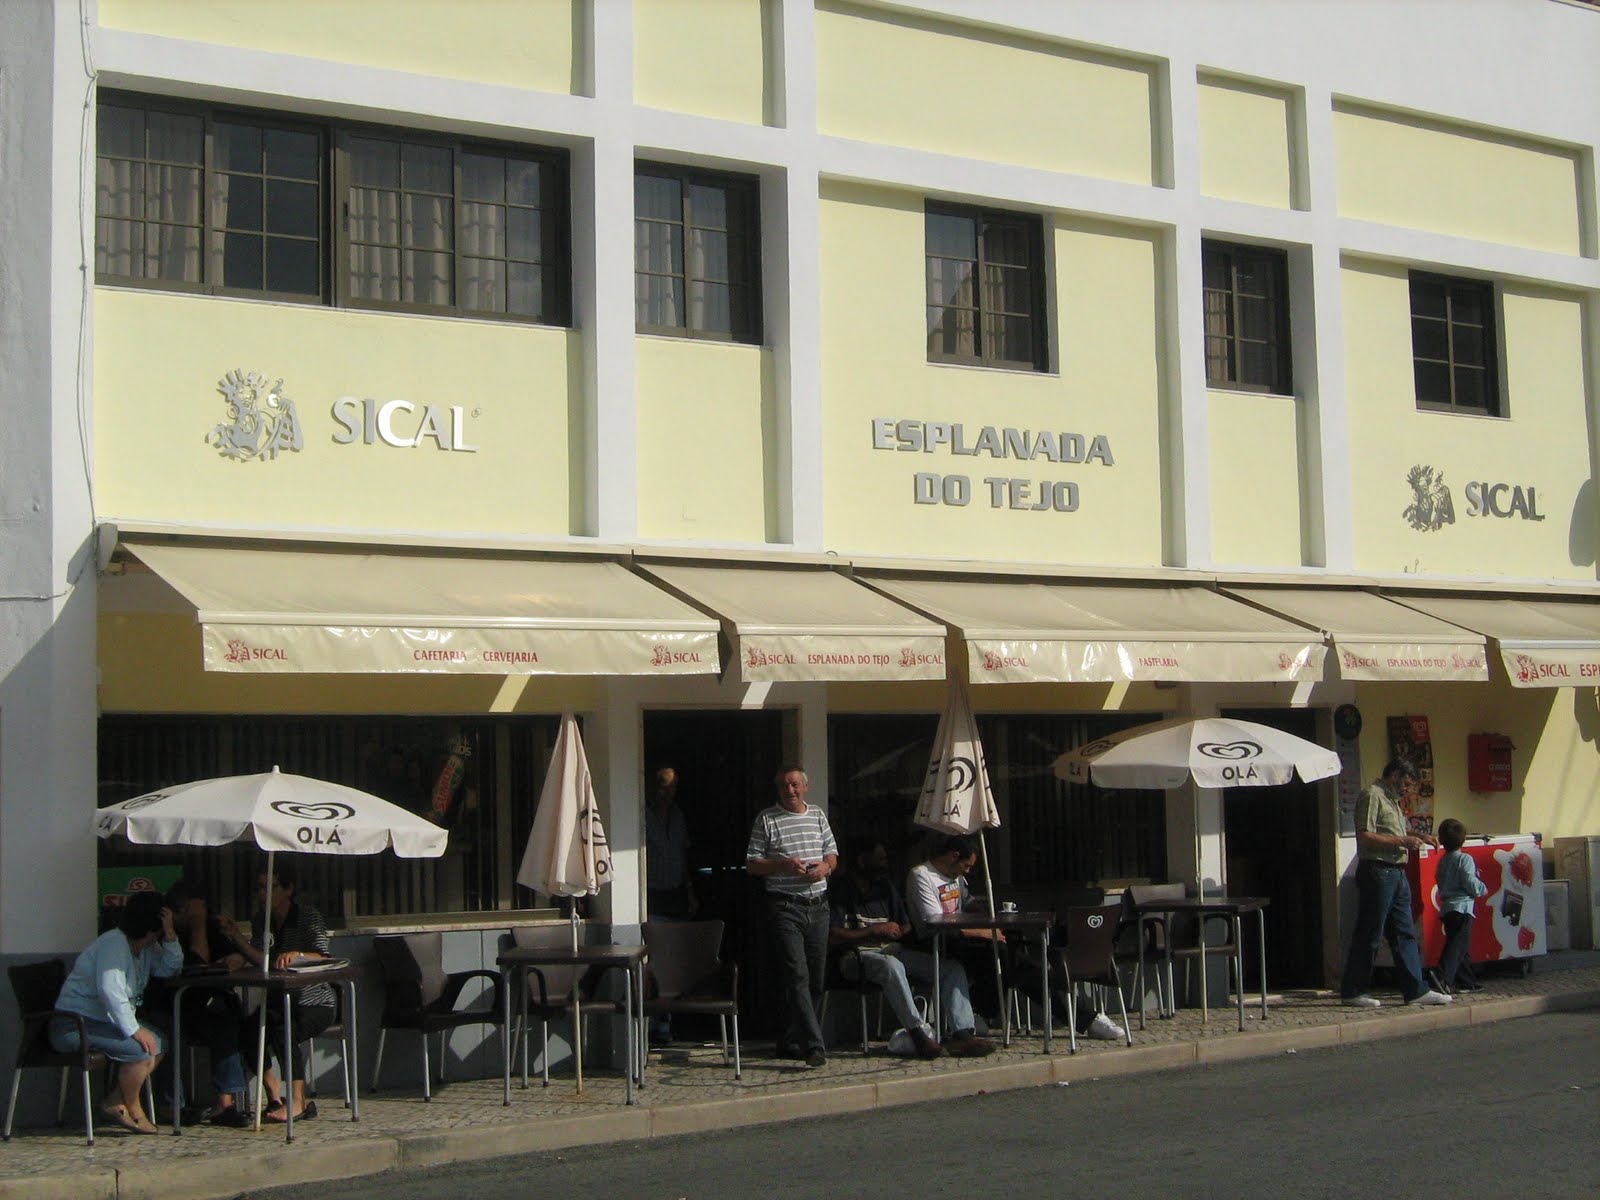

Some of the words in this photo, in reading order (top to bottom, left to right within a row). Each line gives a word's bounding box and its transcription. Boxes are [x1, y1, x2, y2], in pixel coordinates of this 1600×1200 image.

[331, 396, 479, 453] SICAL
[872, 417, 1115, 466] ESPLANADA
[913, 472, 971, 507] DO
[984, 476, 1080, 512] TEJO
[1465, 481, 1546, 521] SICAL
[252, 648, 288, 660] SICAL
[413, 649, 467, 662] CAFETARIA
[483, 651, 538, 664] CERVEJARIA
[673, 652, 702, 663] SICAL
[768, 654, 796, 665] SICAL
[808, 654, 855, 665] ESPLANADA
[858, 654, 870, 665] DO
[873, 654, 890, 667] TEJO
[917, 654, 944, 665] SICAL
[1003, 657, 1028, 667] SICAL
[1358, 657, 1380, 668] SICAL
[1387, 658, 1422, 668] ESPLANADA
[1423, 658, 1433, 668] DO
[1539, 663, 1571, 678] SICAL
[1222, 762, 1258, 780] OLÁ
[296, 824, 343, 846] OLÁ
